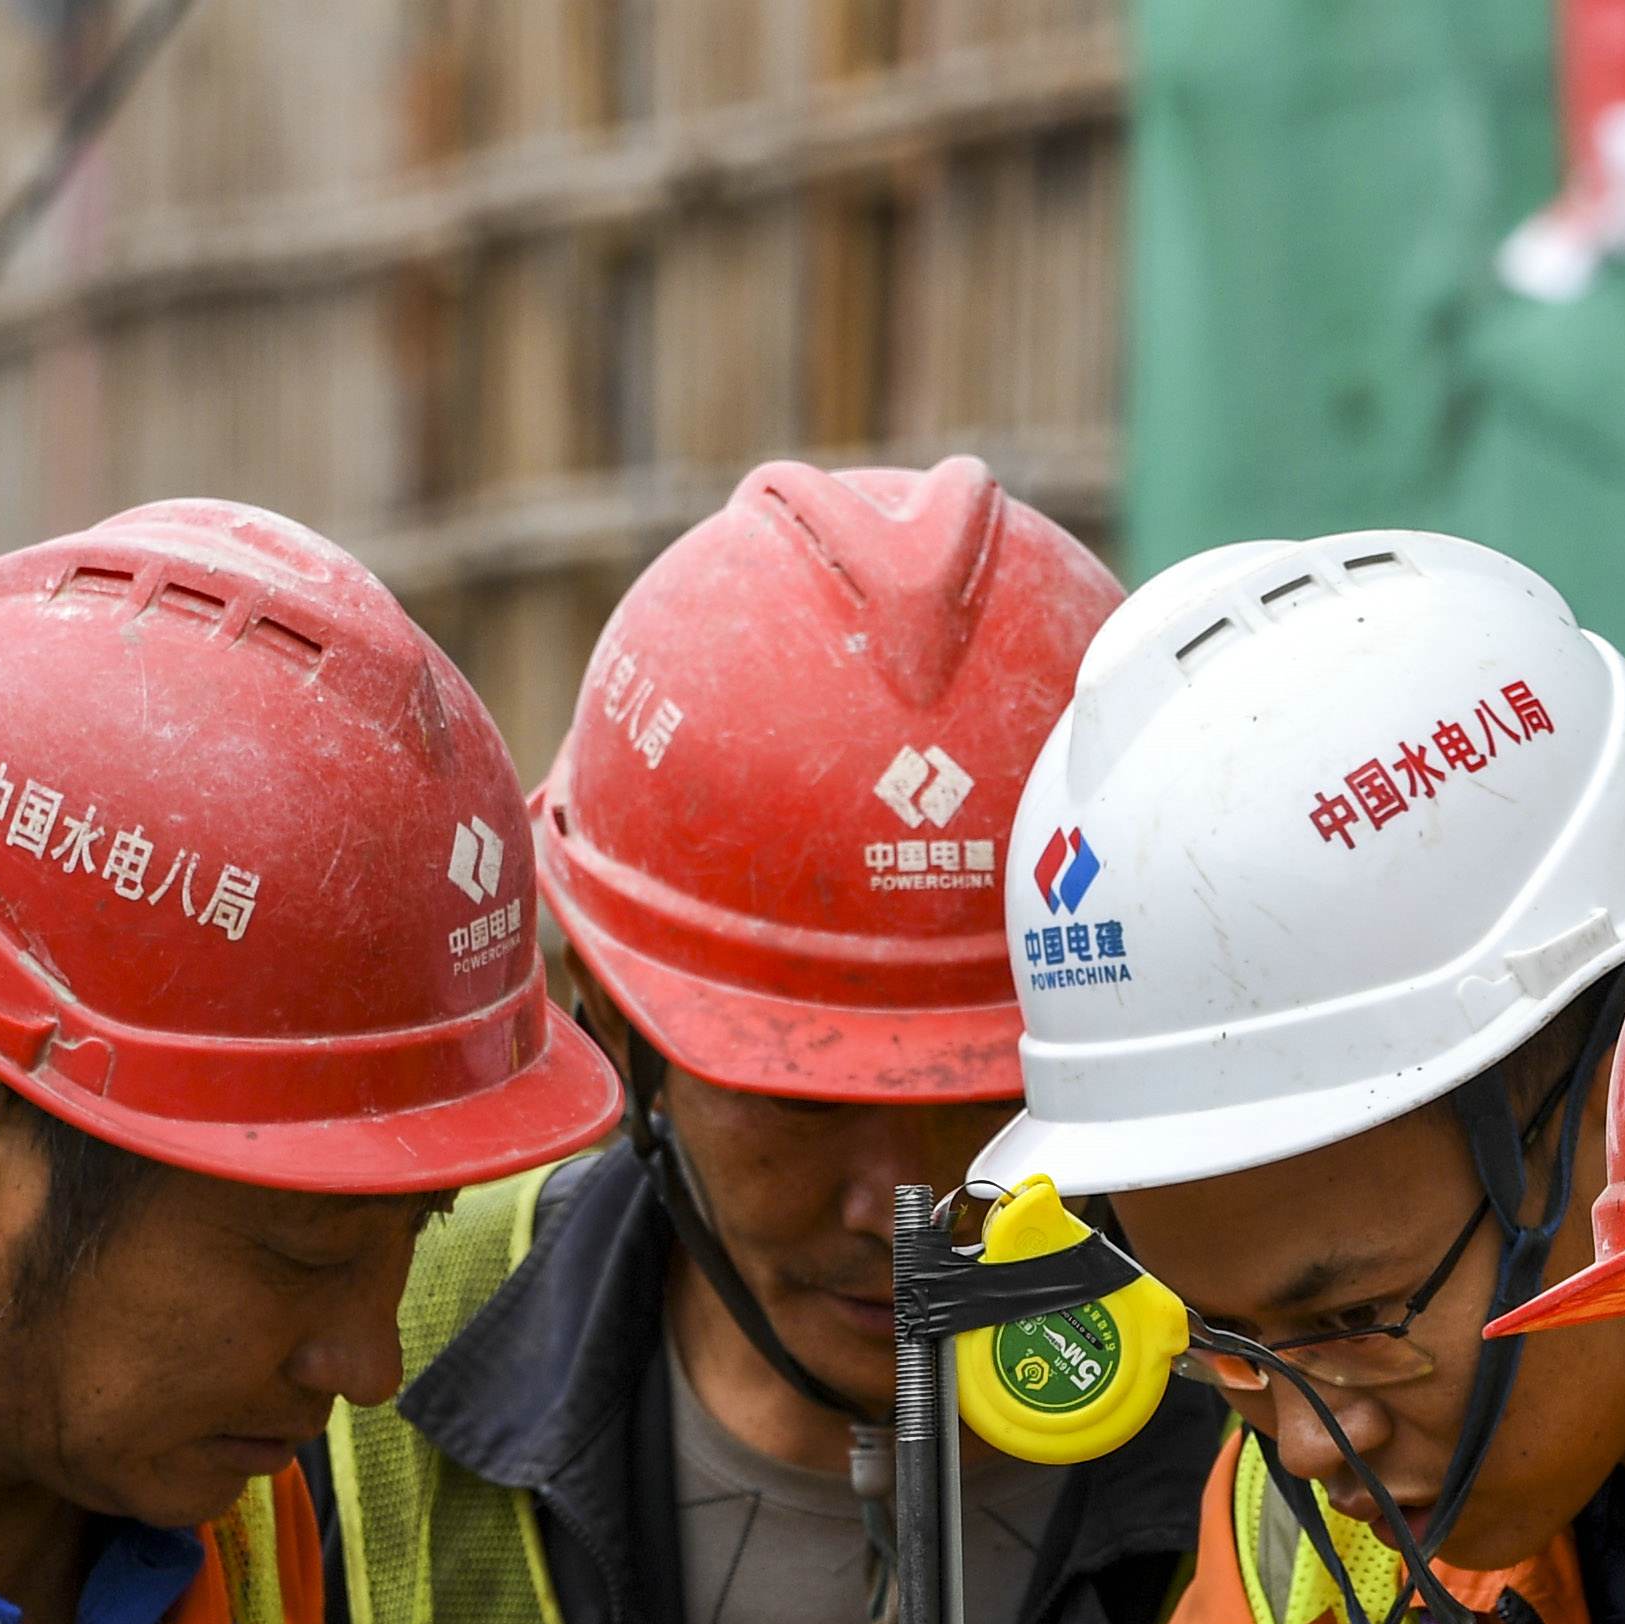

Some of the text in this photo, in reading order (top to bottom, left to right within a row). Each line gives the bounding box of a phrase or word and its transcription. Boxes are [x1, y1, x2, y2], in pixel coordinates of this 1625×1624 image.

[1309, 680, 1555, 850] 中国水电八局
[865, 838, 994, 873] 中国电建
[870, 873, 994, 890] POWERCHINA
[453, 932, 521, 976] POWERCHINA
[1024, 919, 1126, 967] 中国电建
[1030, 963, 1132, 992] POWERCHINA
